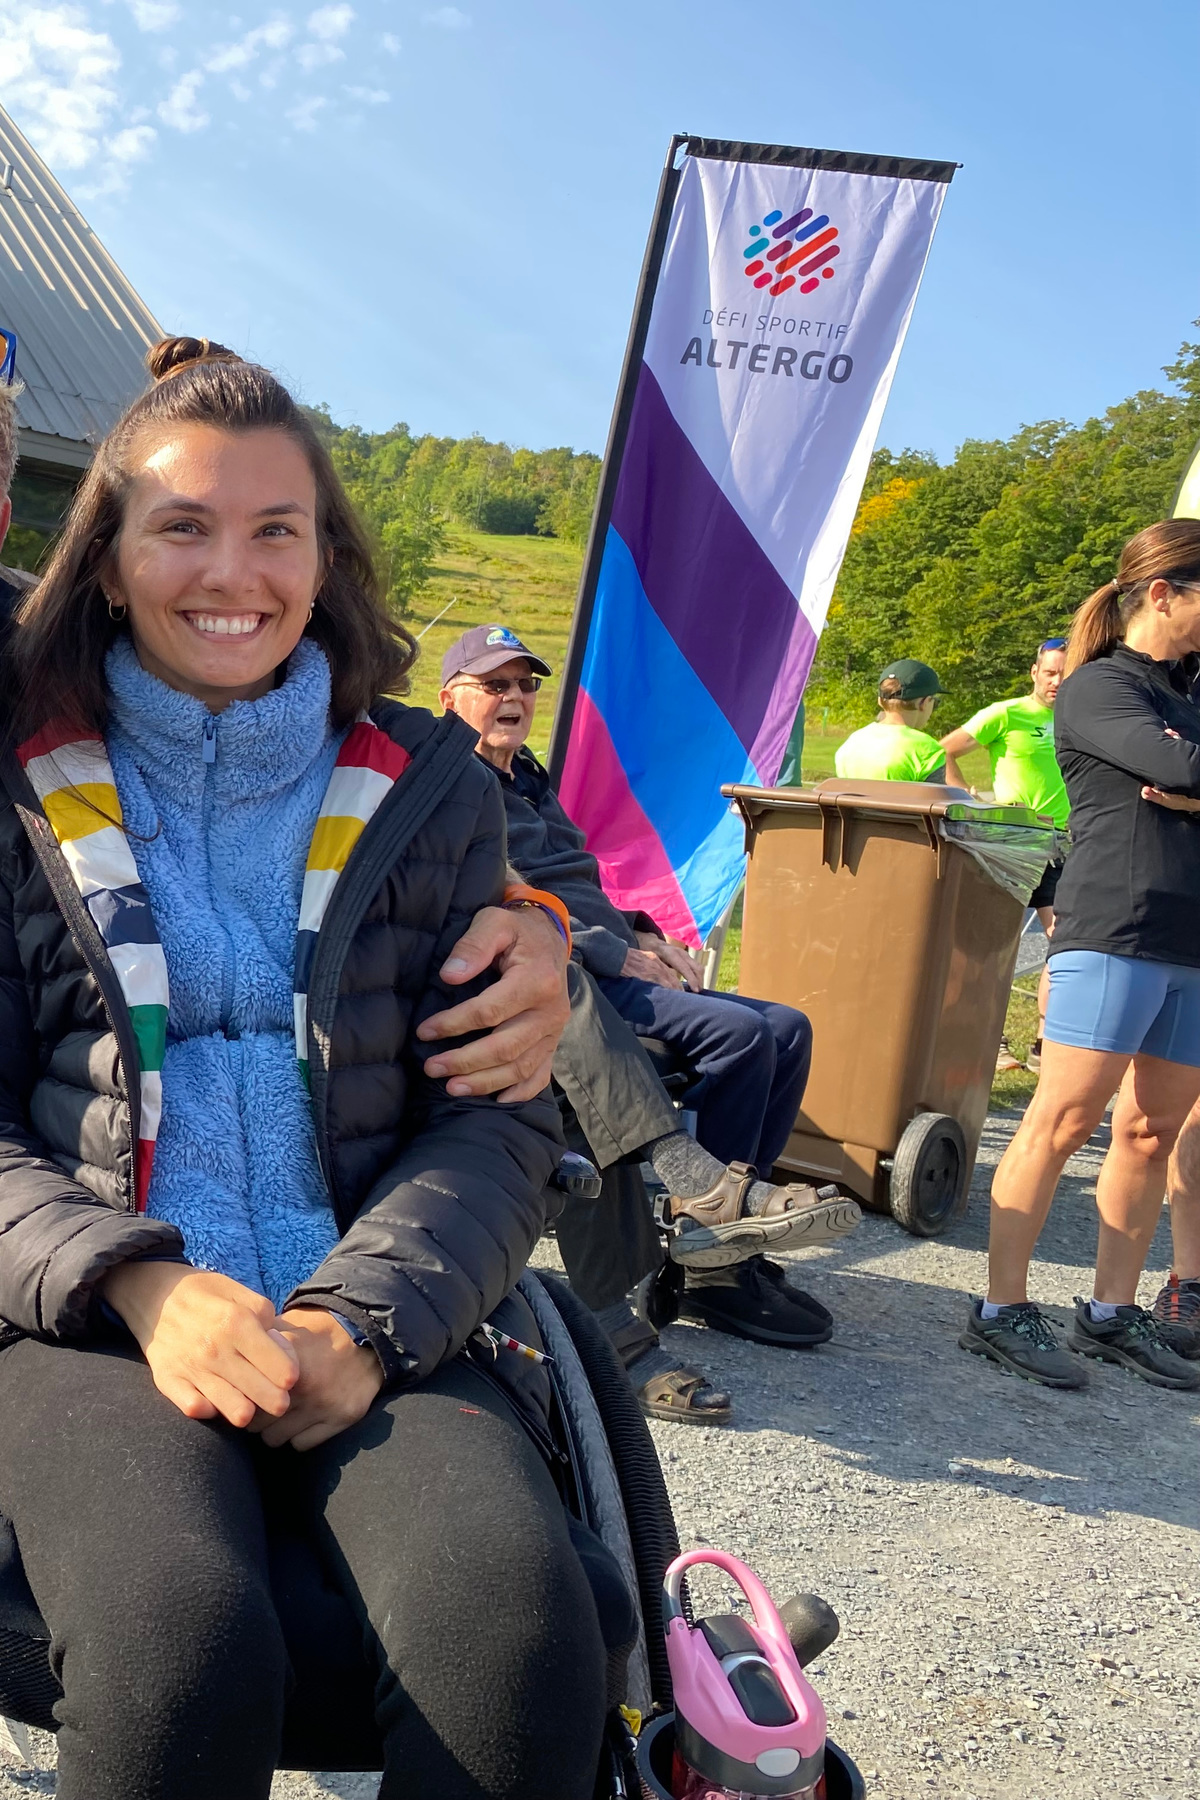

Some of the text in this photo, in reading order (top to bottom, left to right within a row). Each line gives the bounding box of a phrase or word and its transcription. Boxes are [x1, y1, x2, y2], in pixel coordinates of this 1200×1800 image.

[702, 307, 849, 340] DÉFI SPORTIF
[679, 337, 854, 384] ALTERGO
